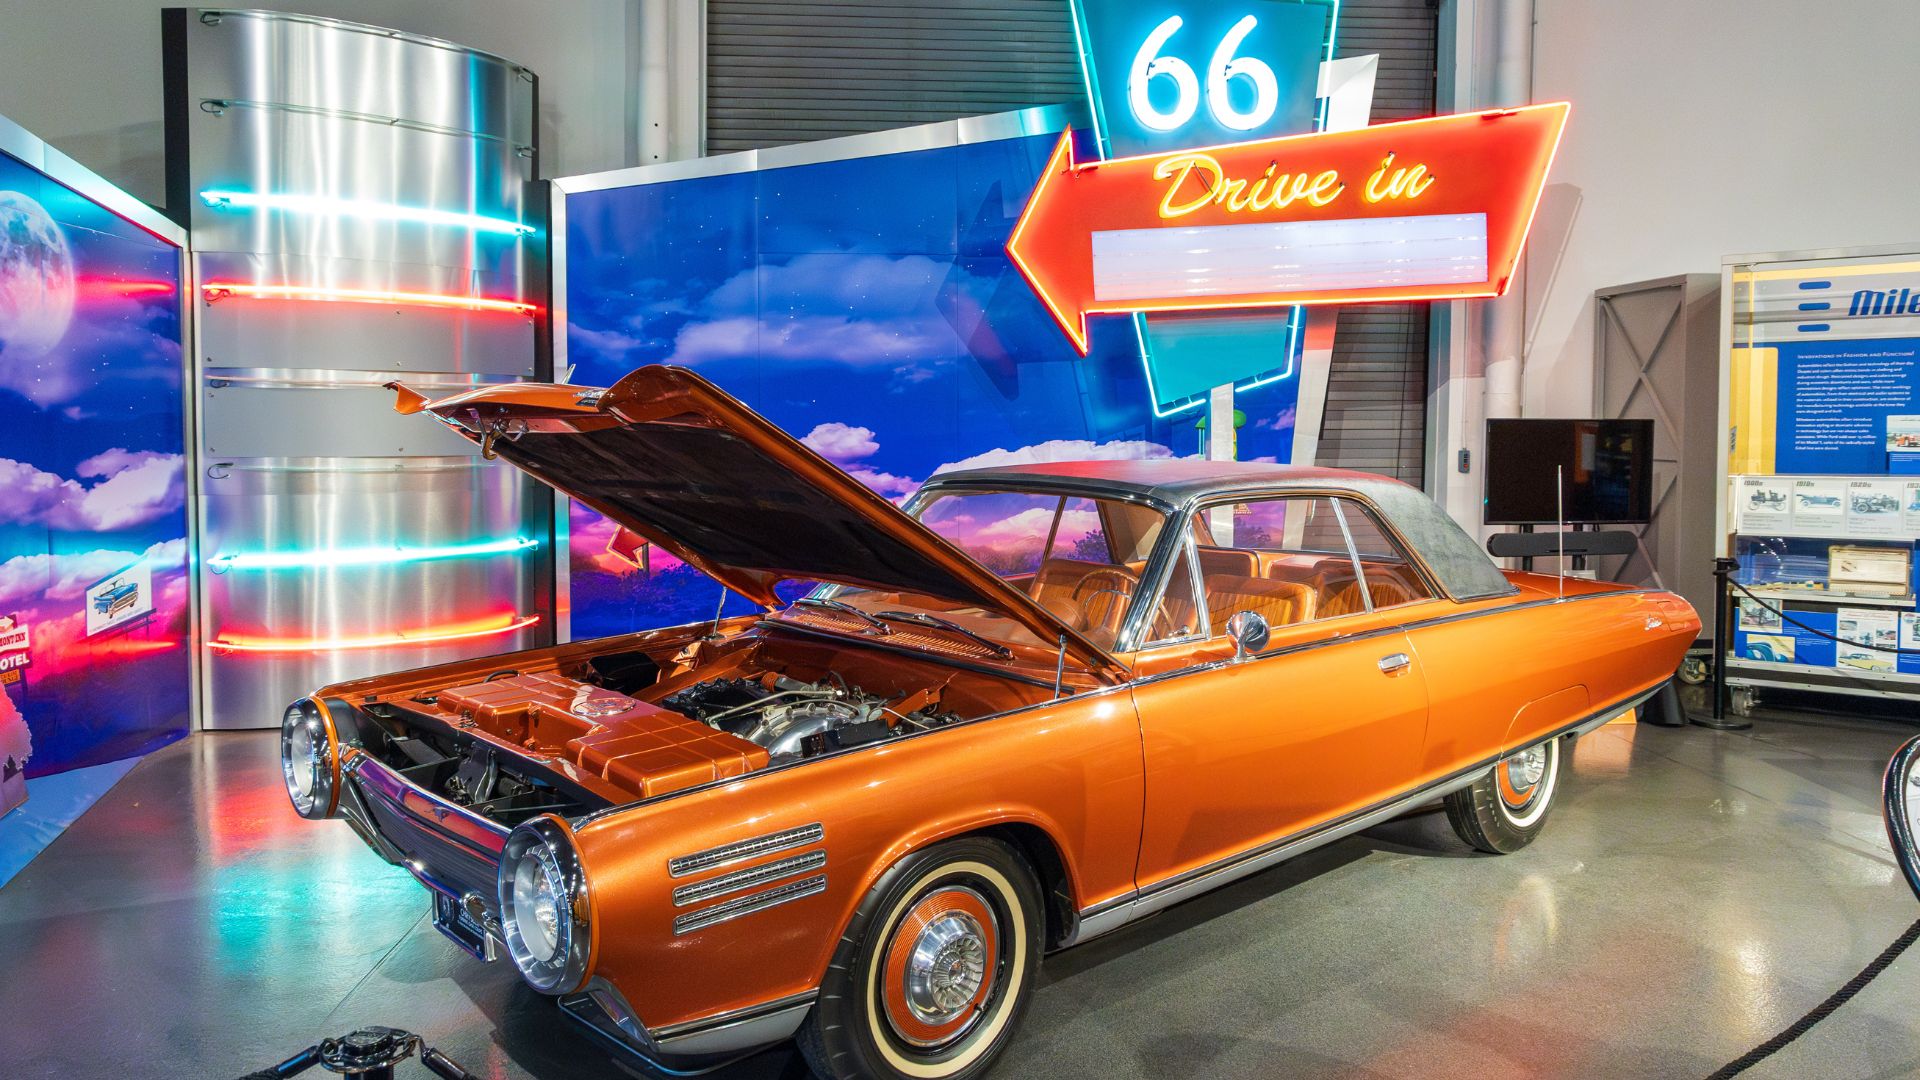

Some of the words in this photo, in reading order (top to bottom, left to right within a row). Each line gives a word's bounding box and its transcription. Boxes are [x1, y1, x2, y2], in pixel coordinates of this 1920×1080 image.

[1129, 13, 1279, 131] 66
[1153, 153, 1344, 219] Drive
[1365, 150, 1435, 204] in
[0, 653, 30, 670] OTEL
